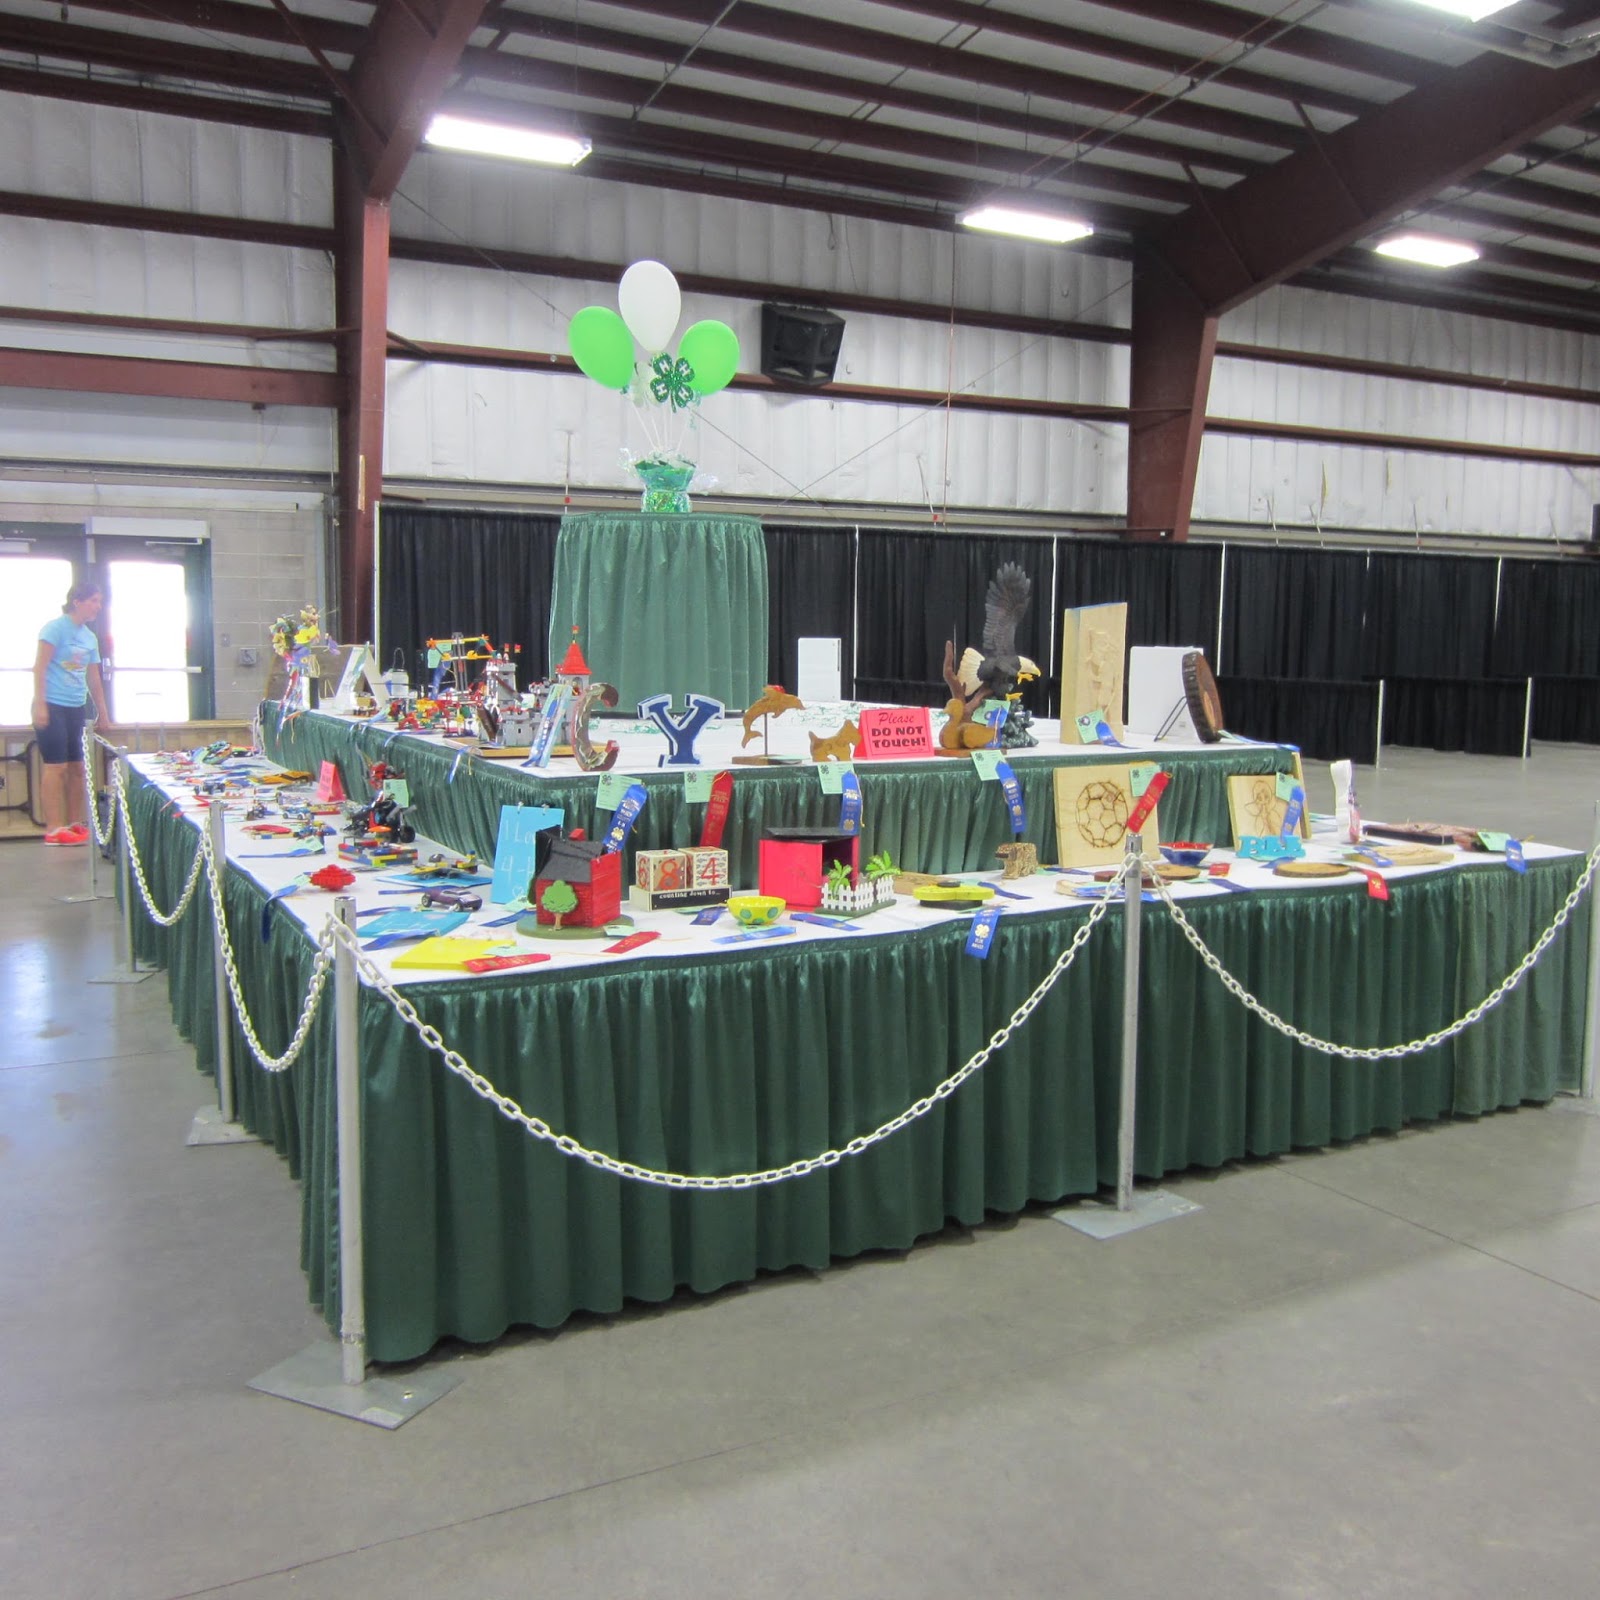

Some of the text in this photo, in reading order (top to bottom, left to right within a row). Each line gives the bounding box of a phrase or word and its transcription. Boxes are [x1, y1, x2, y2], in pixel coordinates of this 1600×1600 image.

[659, 360, 670, 373] H
[679, 363, 690, 377] H
[656, 383, 667, 395] H
[678, 386, 689, 401] H
[878, 712, 915, 726] Please
[637, 693, 725, 768] Y
[871, 726, 924, 737] DO NOT
[872, 737, 926, 749] TOUCH!
[660, 859, 680, 890] 8
[700, 857, 720, 886] 4
[659, 891, 688, 900] counting
